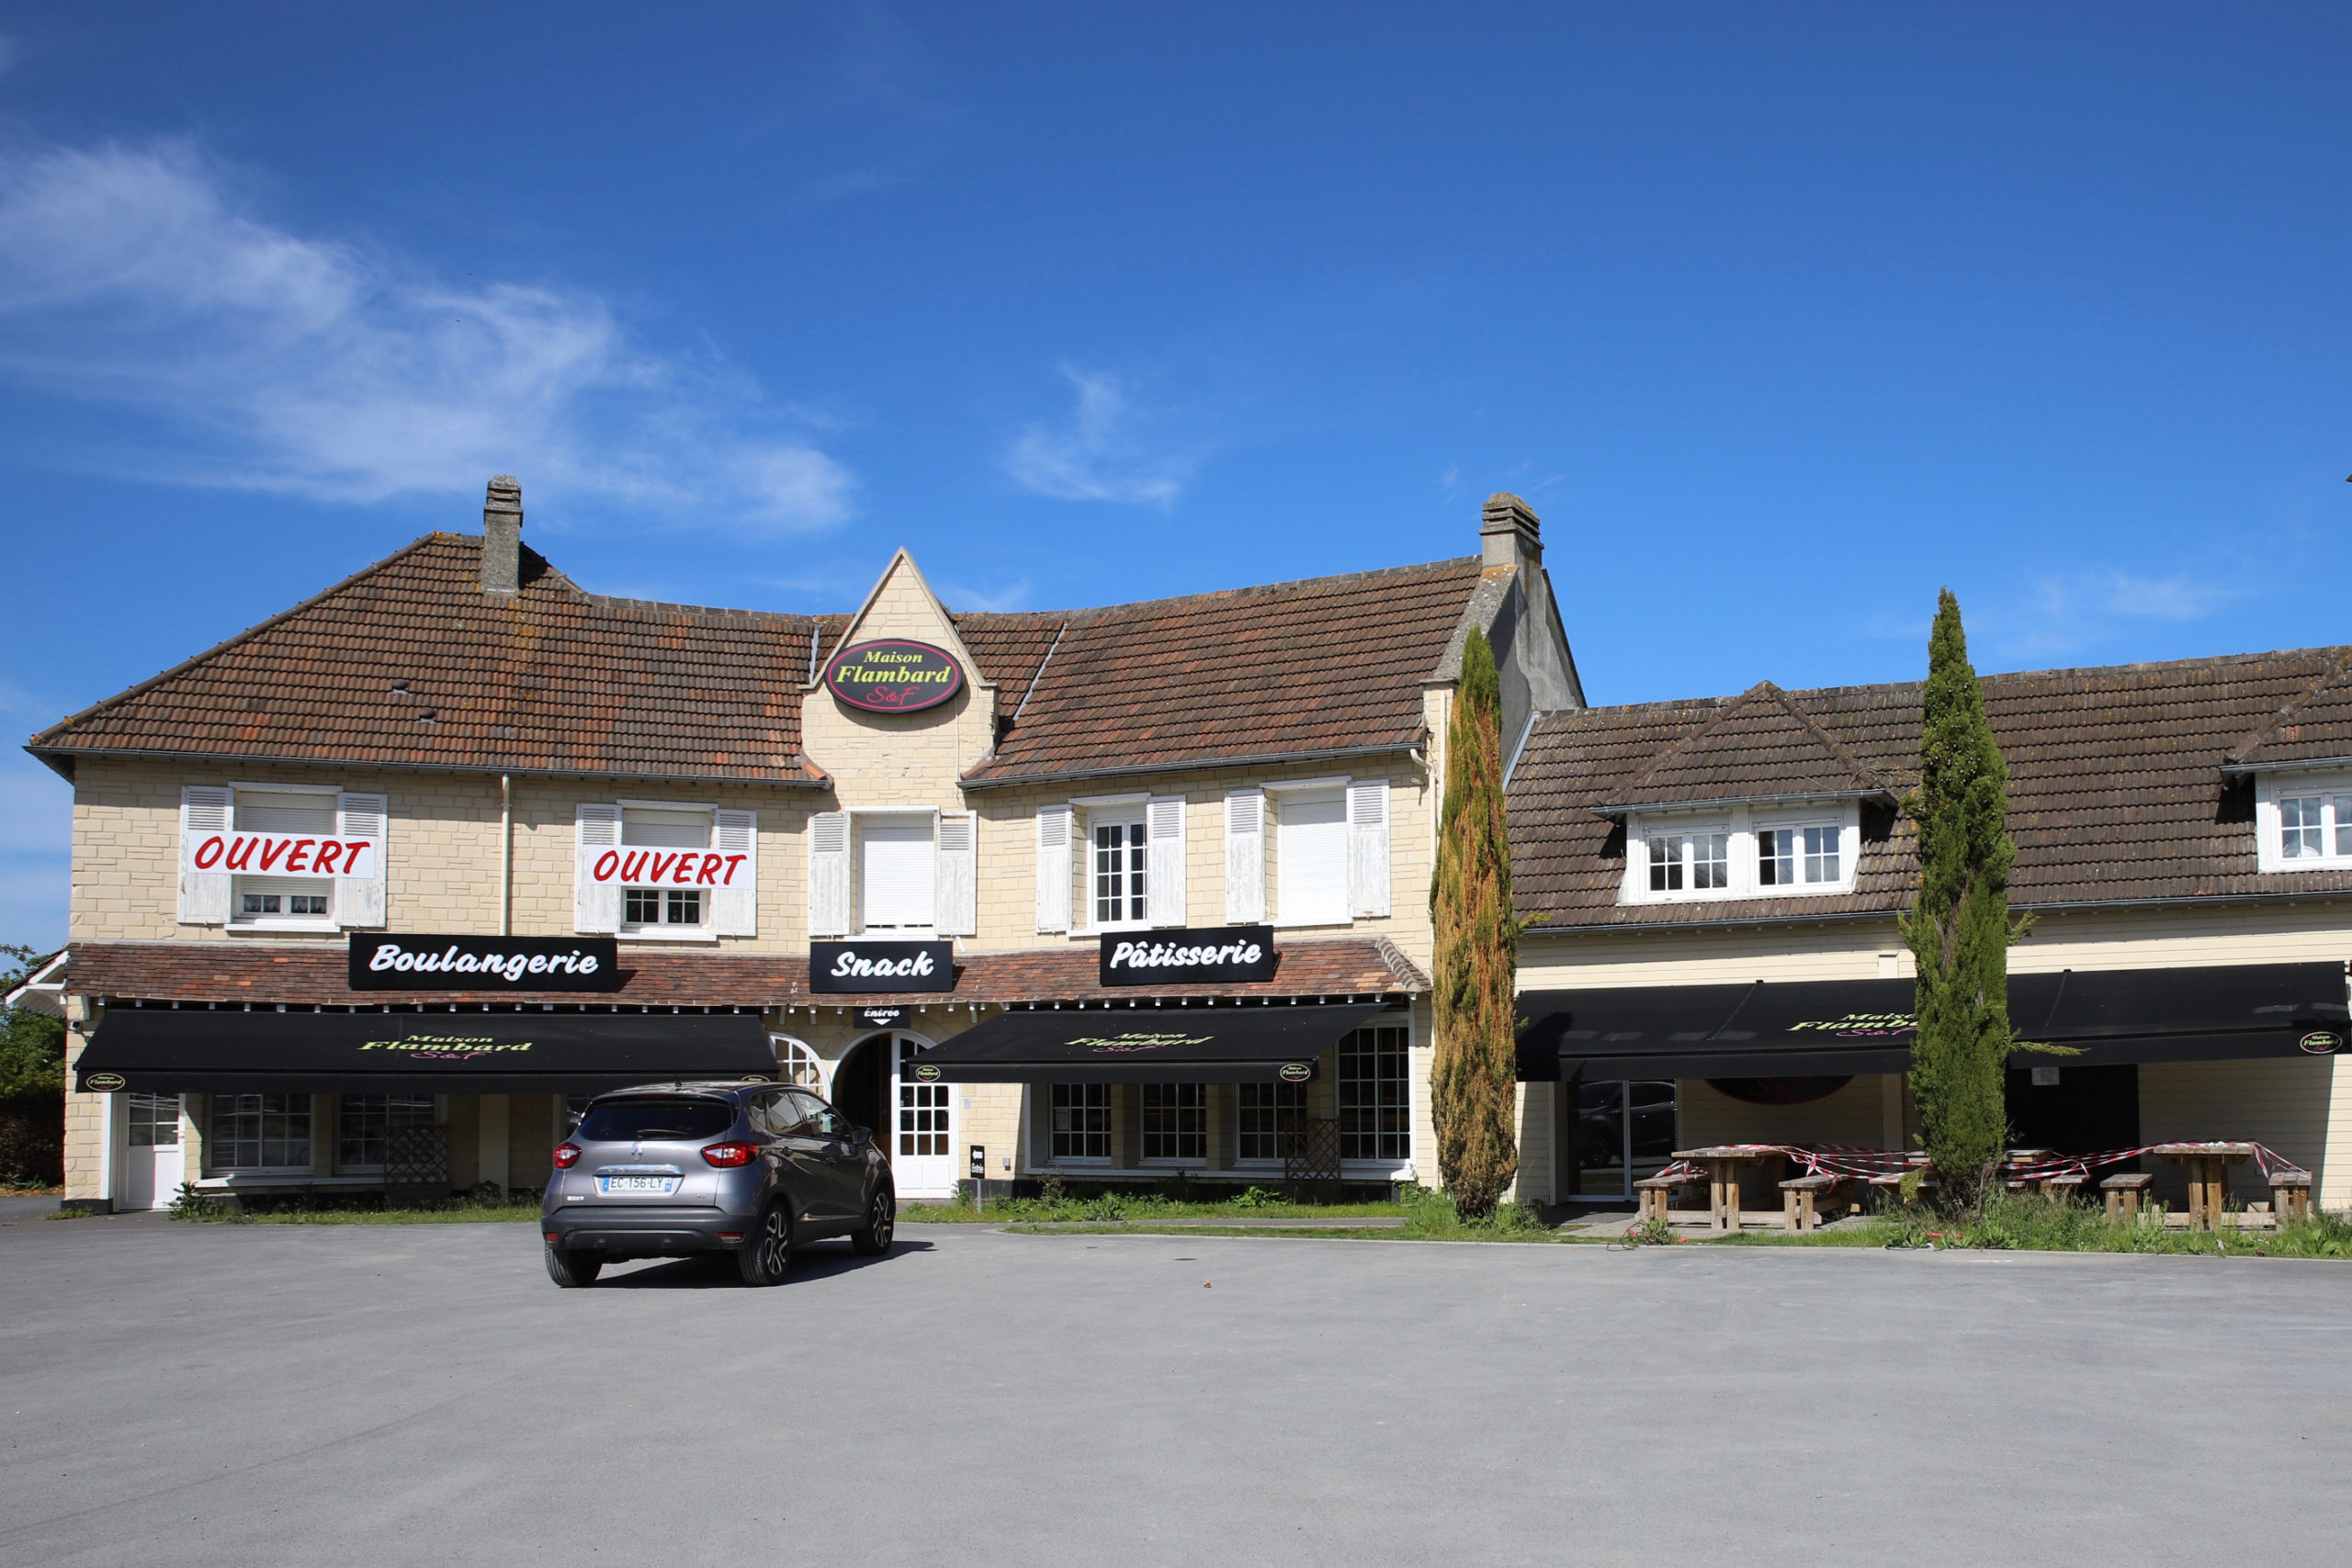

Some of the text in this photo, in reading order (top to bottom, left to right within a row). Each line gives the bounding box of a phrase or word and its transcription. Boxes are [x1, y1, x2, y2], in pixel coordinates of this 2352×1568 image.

[863, 650, 923, 663] Maison
[835, 665, 952, 683] Flambard
[866, 685, 922, 705] S&F
[194, 835, 371, 874] OUVERT
[594, 850, 748, 886] OUVERT
[368, 944, 599, 982] Boulangerie
[1109, 939, 1262, 969] Pâtisserie
[831, 950, 934, 977] Snack
[1785, 1020, 1919, 1032] Flamb
[1838, 1013, 1917, 1021] Maiso
[356, 1041, 532, 1052] Flambard
[406, 1034, 493, 1043] Maison
[1063, 1035, 1215, 1046] Flambard
